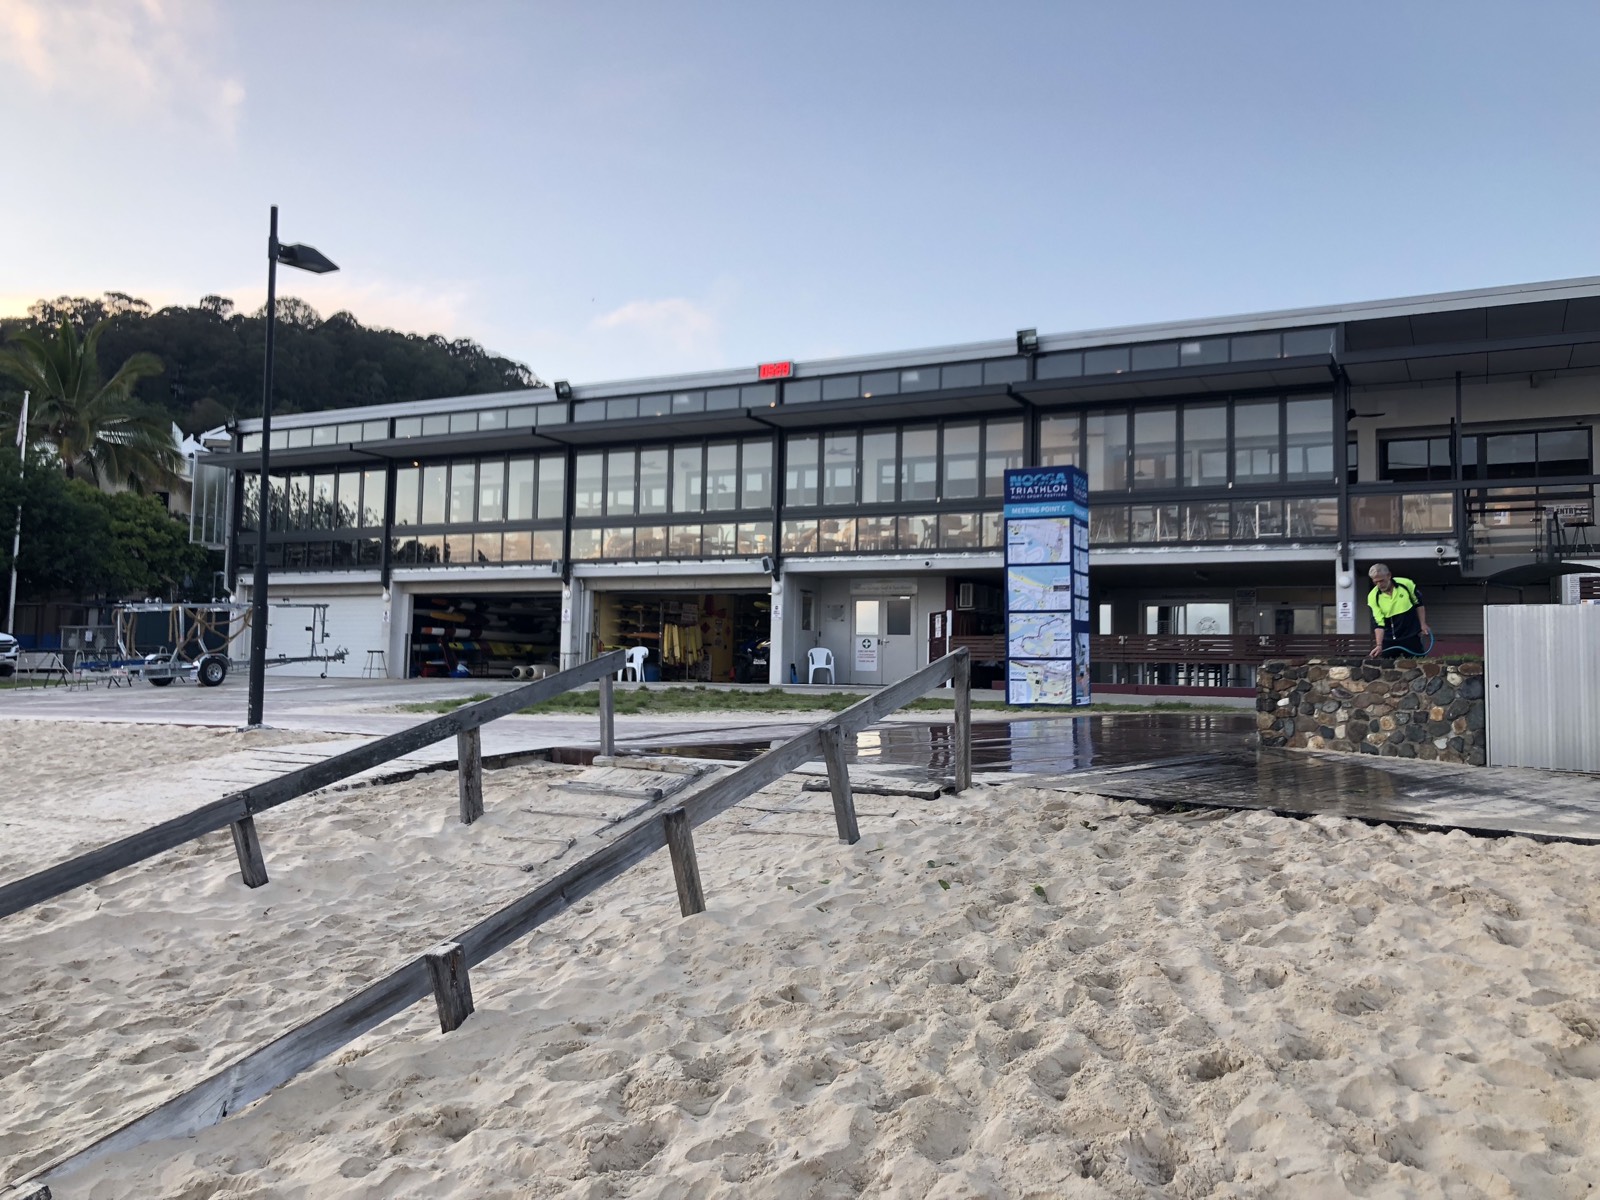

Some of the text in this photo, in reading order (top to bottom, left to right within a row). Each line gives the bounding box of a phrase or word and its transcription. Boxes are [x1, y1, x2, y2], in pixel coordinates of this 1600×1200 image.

[1010, 484, 1067, 494] TRIATHLON
[1011, 505, 1040, 514] MEETING
[1040, 505, 1061, 513] POINT
